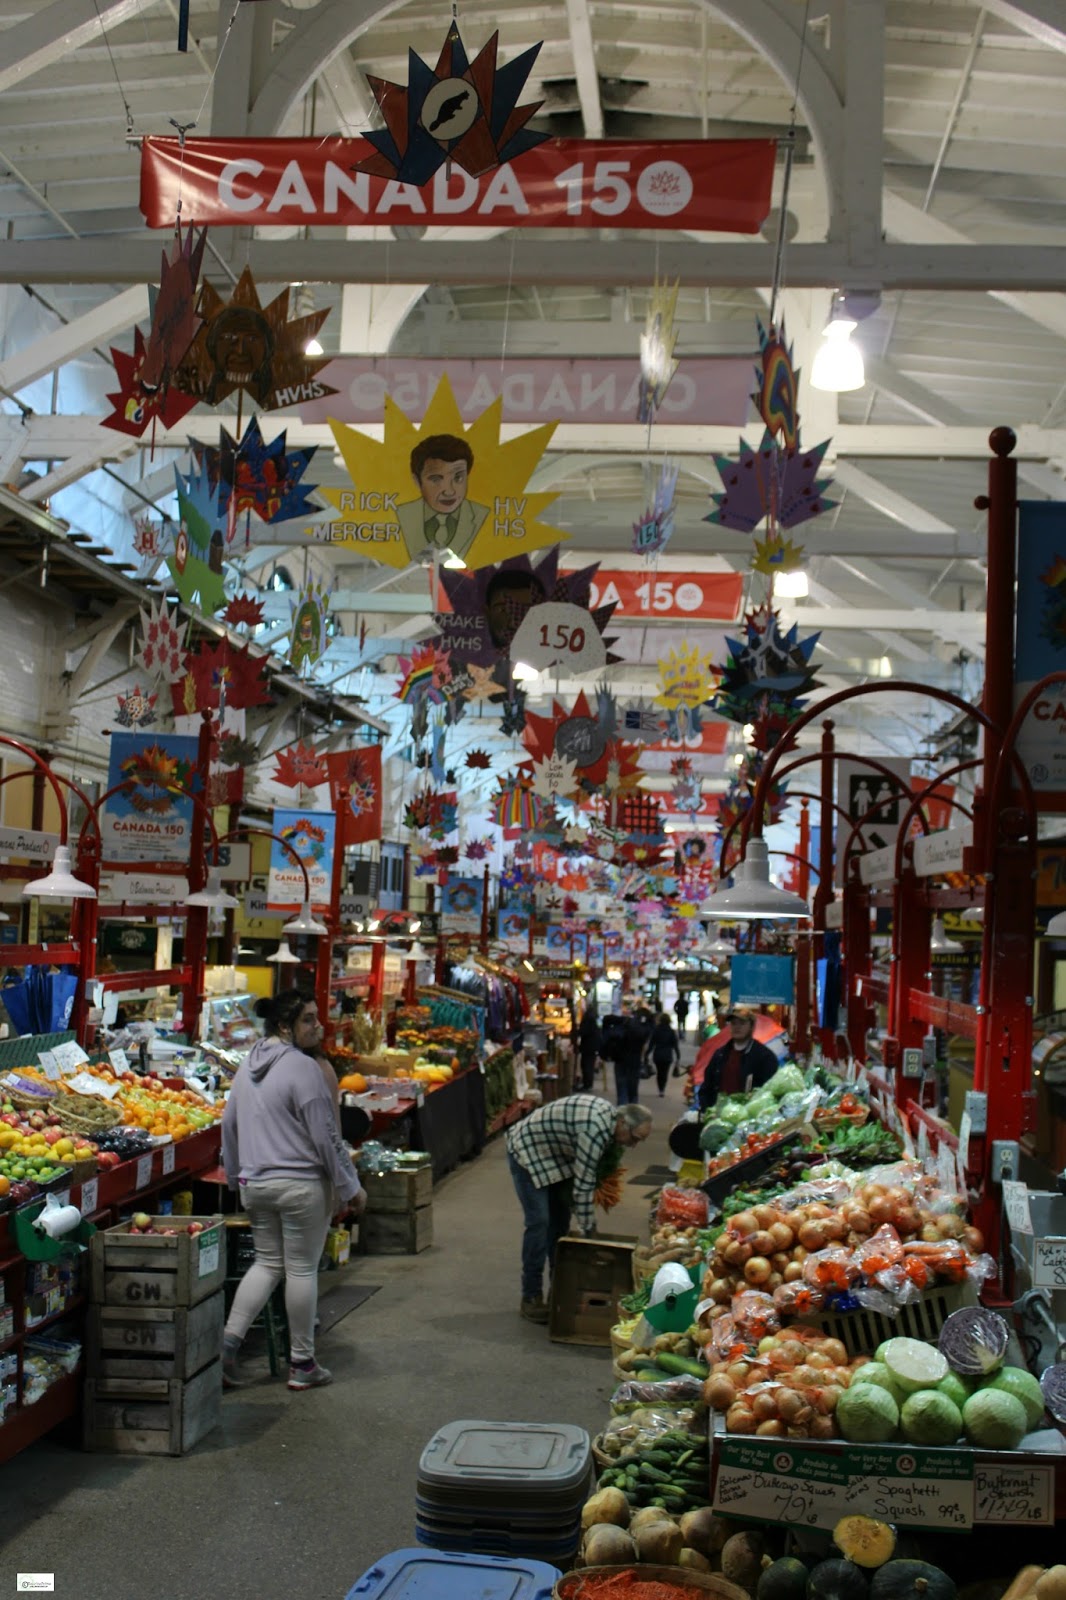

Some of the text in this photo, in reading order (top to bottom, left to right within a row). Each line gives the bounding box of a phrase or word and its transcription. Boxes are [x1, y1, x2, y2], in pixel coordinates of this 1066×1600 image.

[217, 158, 693, 217] CANADA 150
[274, 379, 326, 407] HVHS
[339, 491, 400, 512] RICK
[494, 496, 528, 517] HV
[312, 522, 401, 543] MERCER
[493, 519, 526, 538] HS
[635, 582, 704, 611] 150
[440, 635, 482, 650] HVHS
[539, 624, 585, 653] 150
[113, 820, 184, 836] CANADA 150
[275, 873, 304, 883] CANAD
[126, 1282, 162, 1301] GW
[741, 1447, 755, 1458] Very
[756, 1449, 770, 1459] Best
[876, 1477, 941, 1504] Spaghetti
[874, 1498, 926, 1520] Squash
